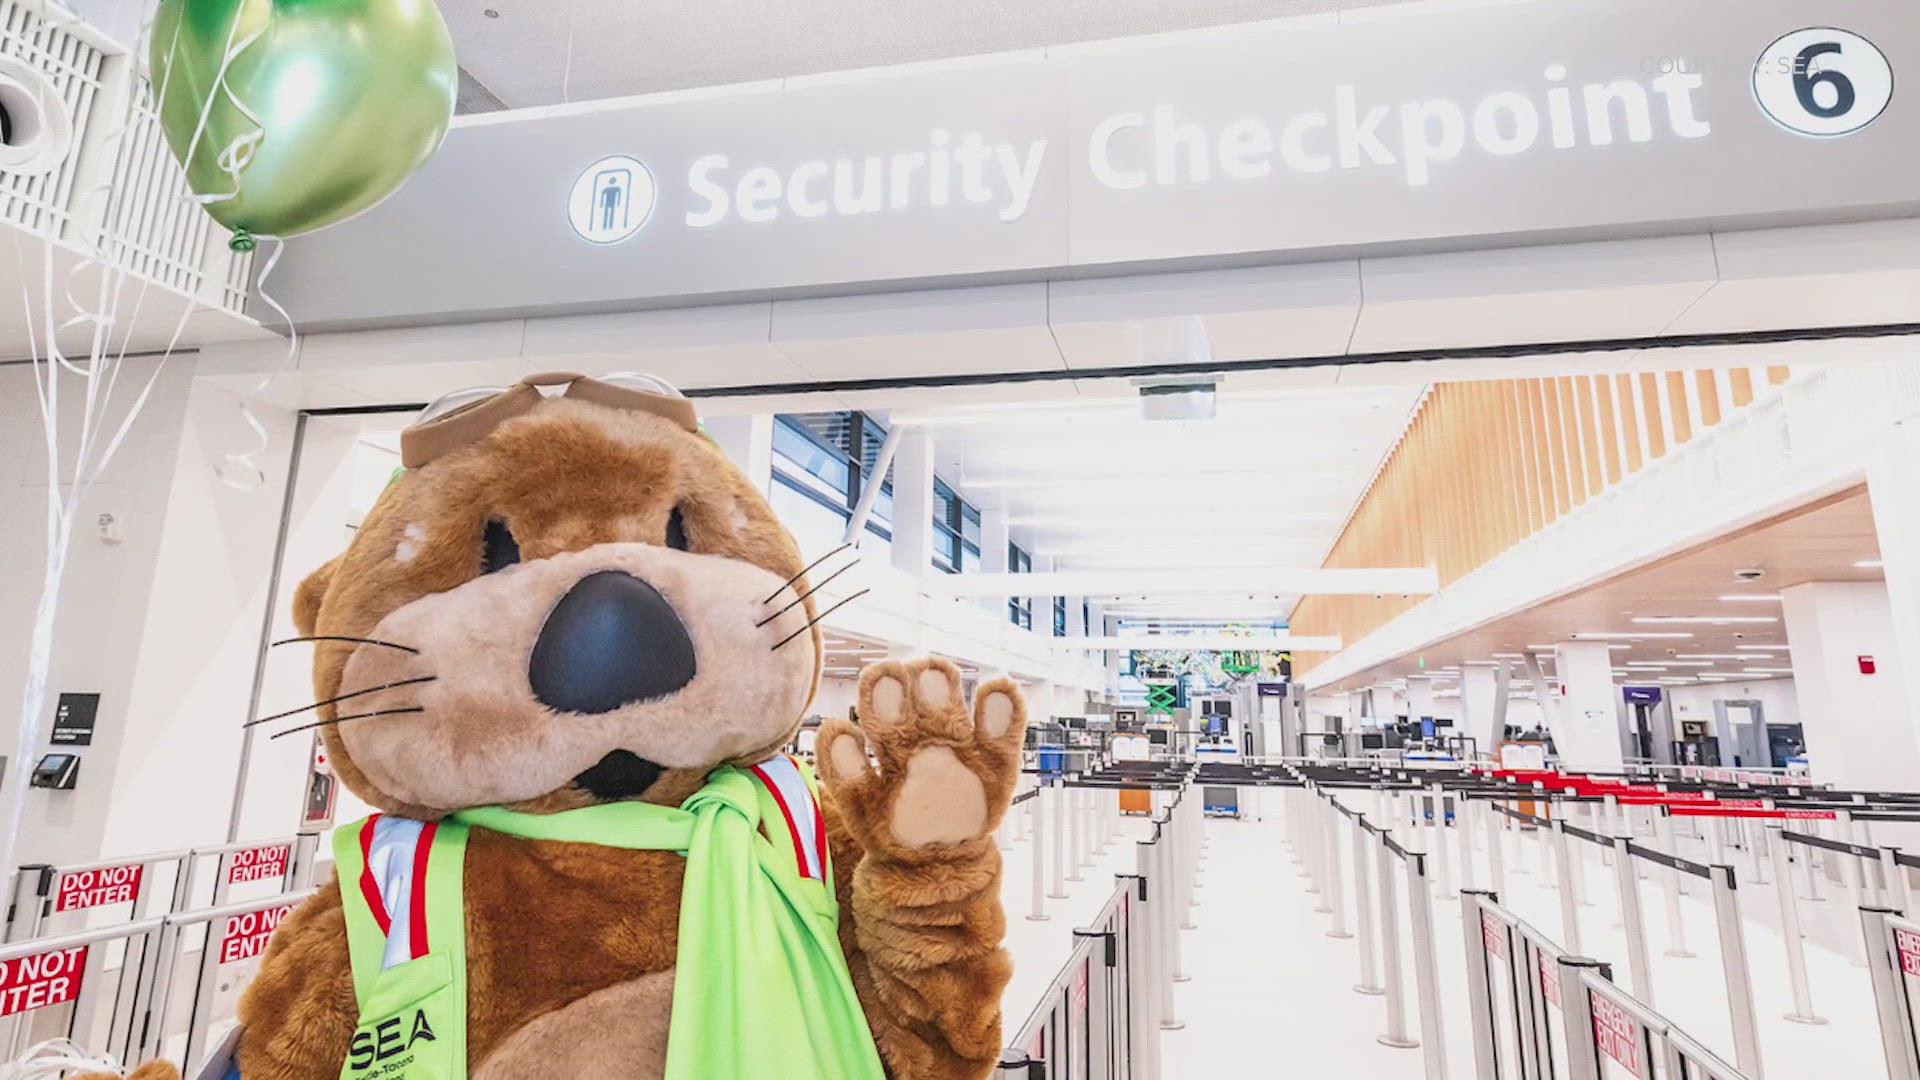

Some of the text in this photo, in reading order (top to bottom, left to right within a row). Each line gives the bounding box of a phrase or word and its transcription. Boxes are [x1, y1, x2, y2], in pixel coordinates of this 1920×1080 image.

[685, 42, 1856, 228] Security Checkpoint 6
[232, 861, 282, 882] ENTER
[233, 846, 287, 867] DO NOT
[62, 866, 141, 893] DO NOT
[63, 884, 132, 911] ENTER
[225, 905, 294, 938] DO NO
[224, 932, 273, 962] ENT
[16, 947, 84, 984] NOT
[350, 1009, 436, 1070] SEA
